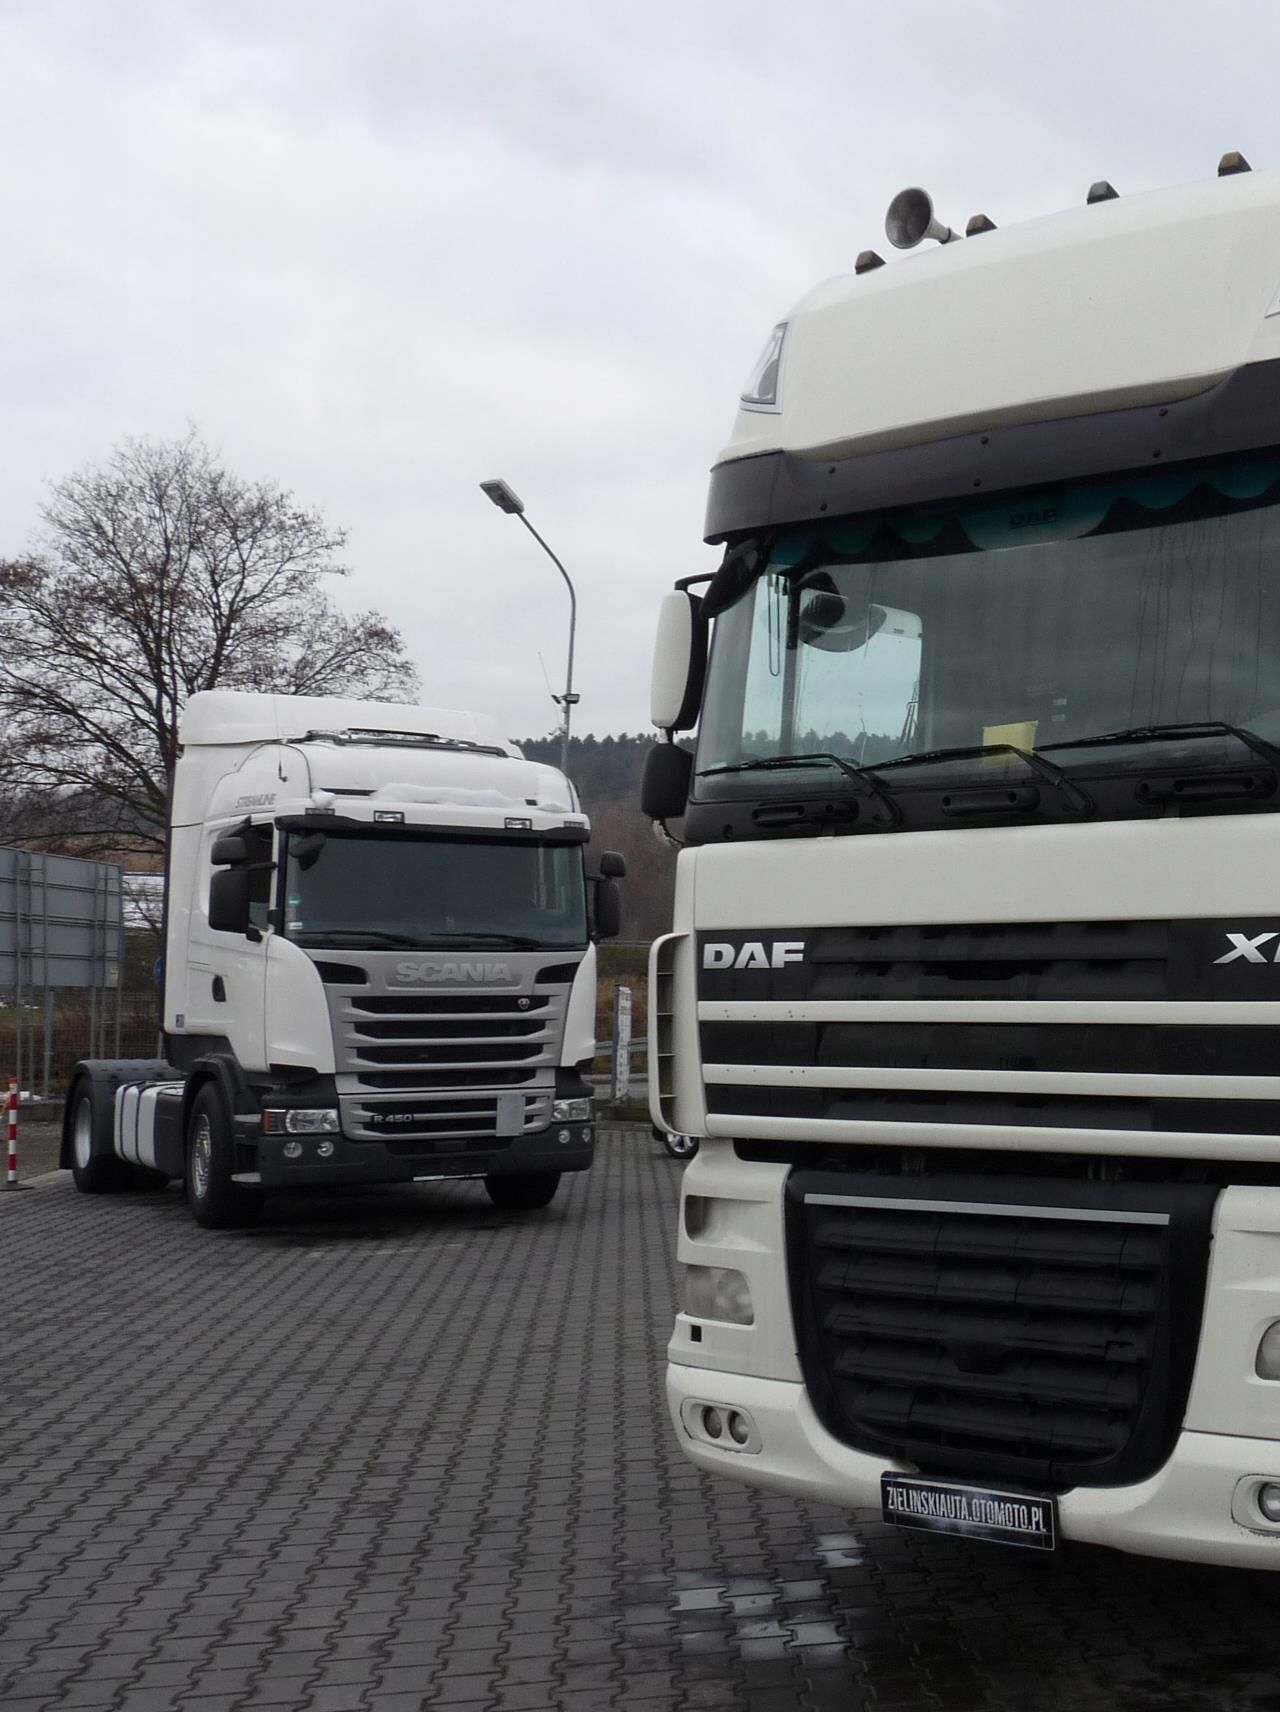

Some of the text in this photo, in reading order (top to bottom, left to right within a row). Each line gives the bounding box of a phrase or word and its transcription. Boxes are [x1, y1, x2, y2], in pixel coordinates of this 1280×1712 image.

[703, 941, 805, 970] DAF
[395, 961, 513, 983] SCANIA
[373, 1113, 413, 1124] R 450
[886, 1486, 1047, 1533] ZIELINSKIAUTA.OTOMOTO.PL
